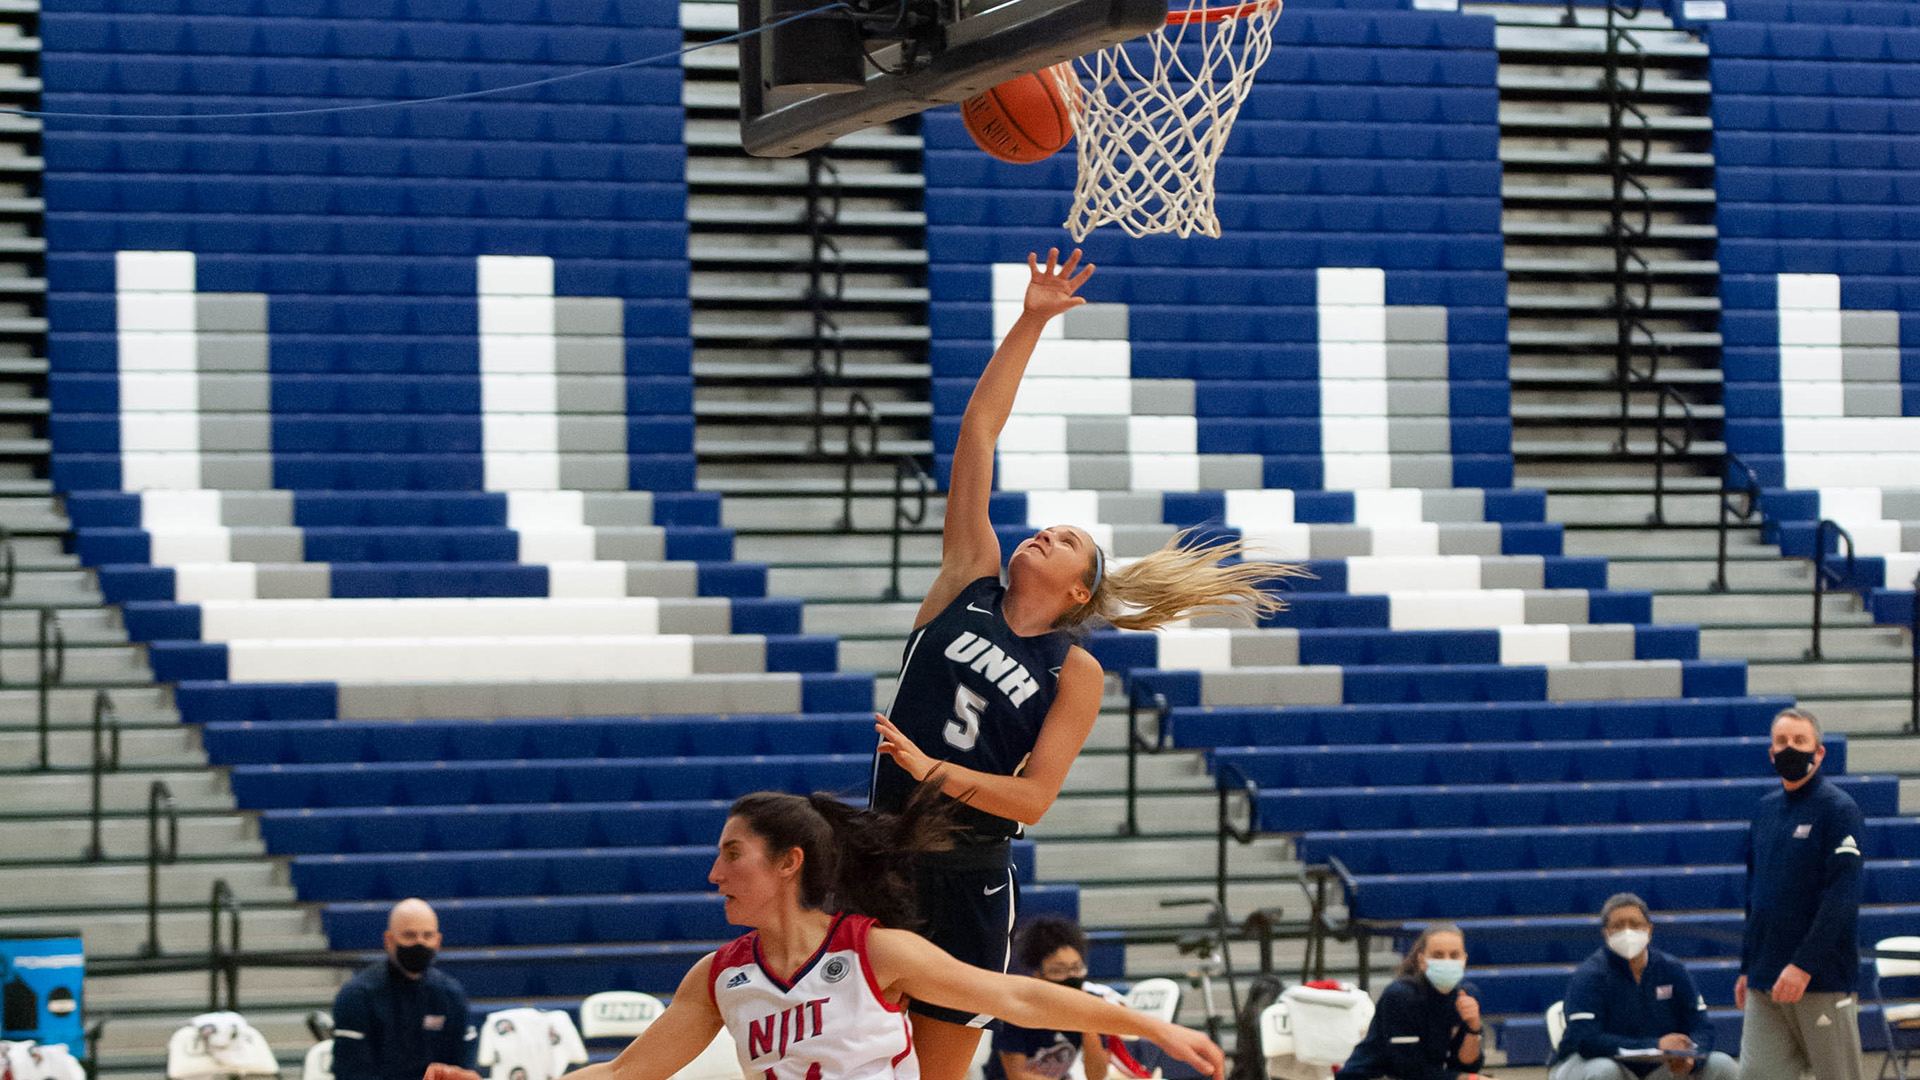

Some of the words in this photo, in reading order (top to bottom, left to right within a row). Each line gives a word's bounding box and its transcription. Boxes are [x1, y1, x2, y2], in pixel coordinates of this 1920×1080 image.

[944, 631, 1041, 709] UNH
[942, 682, 990, 752] 5
[748, 997, 831, 1061] NJIT
